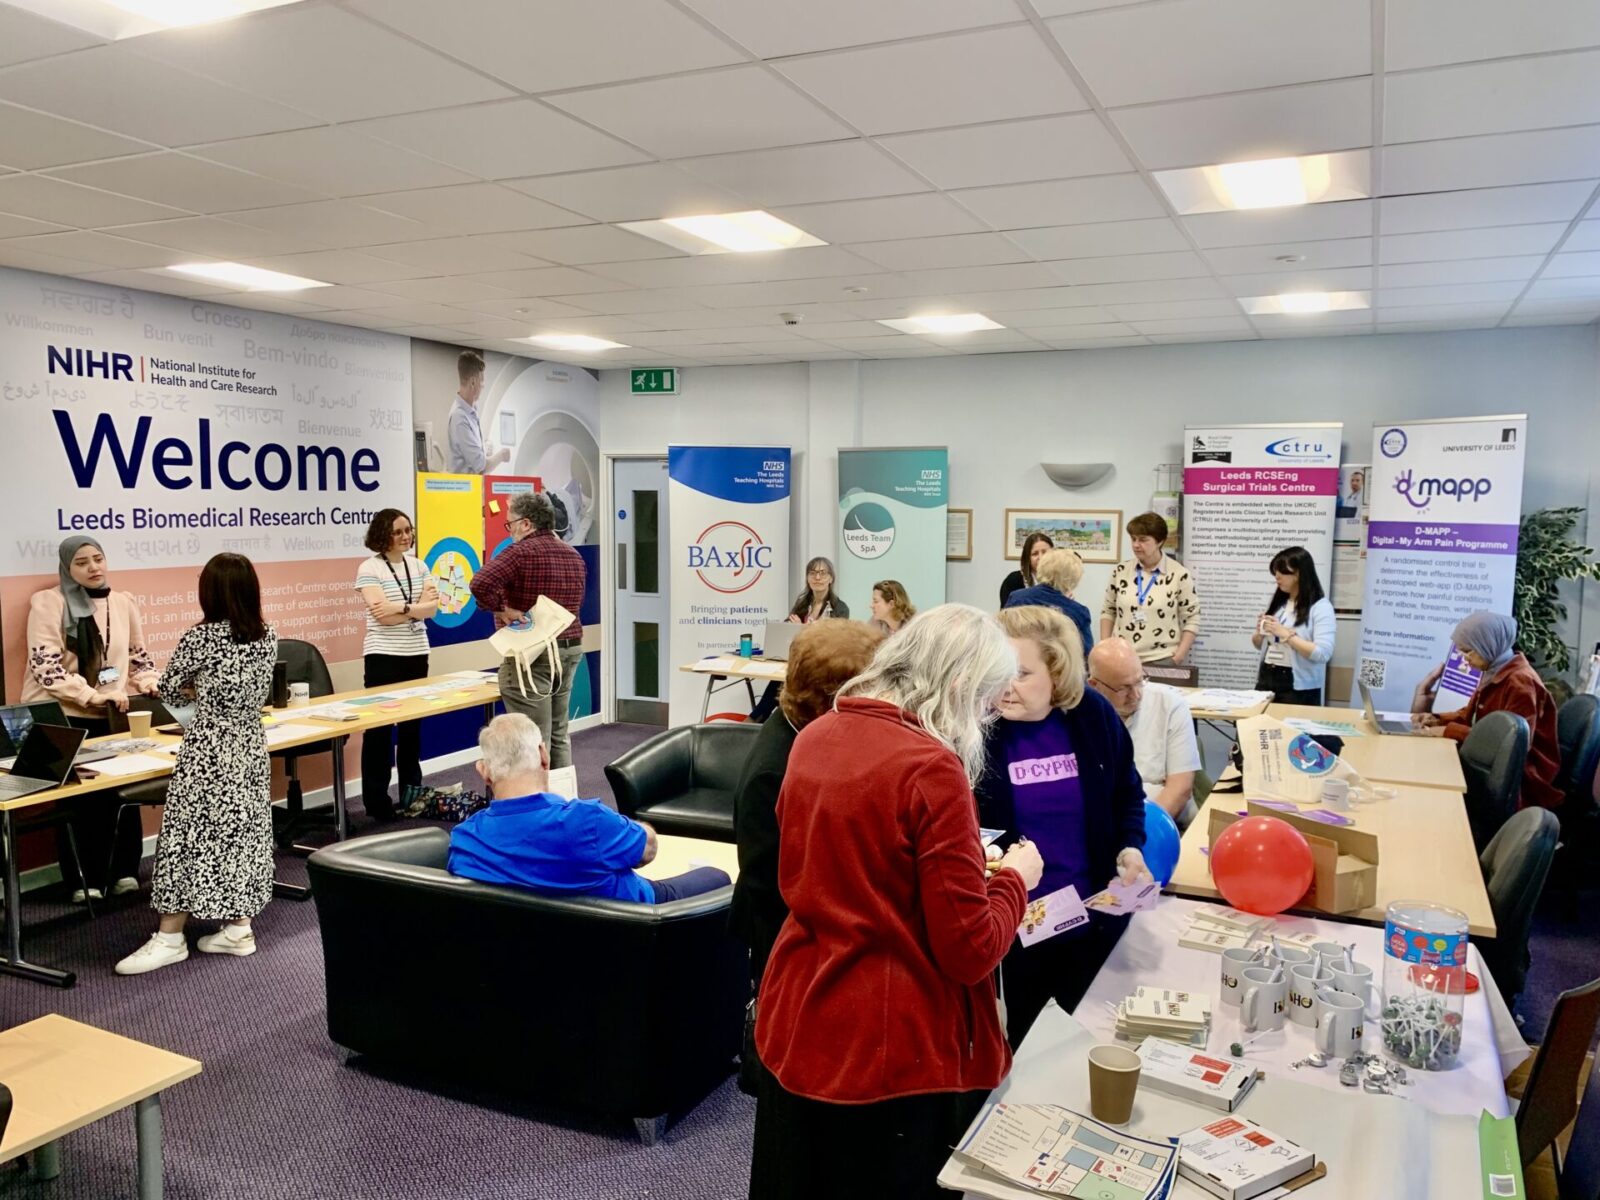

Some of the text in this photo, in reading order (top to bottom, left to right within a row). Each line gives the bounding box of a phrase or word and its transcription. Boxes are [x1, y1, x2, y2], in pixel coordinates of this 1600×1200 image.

[5, 312, 94, 337] Willkommen
[191, 305, 252, 330] Croeso
[144, 324, 214, 348] Bun venit
[244, 338, 338, 370] Bem-vindo
[48, 345, 134, 382] NIHR
[150, 358, 256, 380] National Institute for
[151, 374, 278, 396] Health and Care Research
[129, 389, 189, 412] ようこそ
[370, 407, 404, 432] 欢迎
[298, 420, 362, 438] Bienvenue
[52, 410, 381, 492] Welcome
[1282, 442, 1322, 452] ctru
[764, 462, 784, 470] NHS
[922, 470, 941, 479] NHS
[1220, 471, 1298, 482] Leeds RCSEng
[1203, 483, 1316, 493] Surgical Trials Centre
[58, 508, 124, 530] Leeds
[133, 506, 242, 528] Biomedical
[250, 506, 325, 526] Research
[846, 534, 890, 542] Leeds Team
[1415, 527, 1451, 536] D-MAPP
[283, 537, 334, 552] Welkom
[860, 545, 876, 554] SpA
[1372, 536, 1508, 550] Digital My Arm Pain Programme
[1391, 557, 1432, 565] randomised
[1380, 567, 1413, 575] determine
[1430, 570, 1478, 579] effectiveness
[262, 584, 293, 596] search
[296, 582, 326, 594] Centre
[1382, 578, 1417, 587] developed
[150, 592, 184, 606] Leeds
[1381, 589, 1409, 598] improve
[262, 596, 345, 613] ntre of excellence
[690, 604, 768, 614] Bringing patients
[152, 612, 160, 624] is
[164, 612, 178, 623] an
[282, 614, 319, 629] support
[678, 616, 742, 625] and clinicians
[306, 628, 342, 641] support
[343, 624, 358, 635] the
[706, 642, 740, 650] partnersh
[1258, 729, 1269, 750] NIHR
